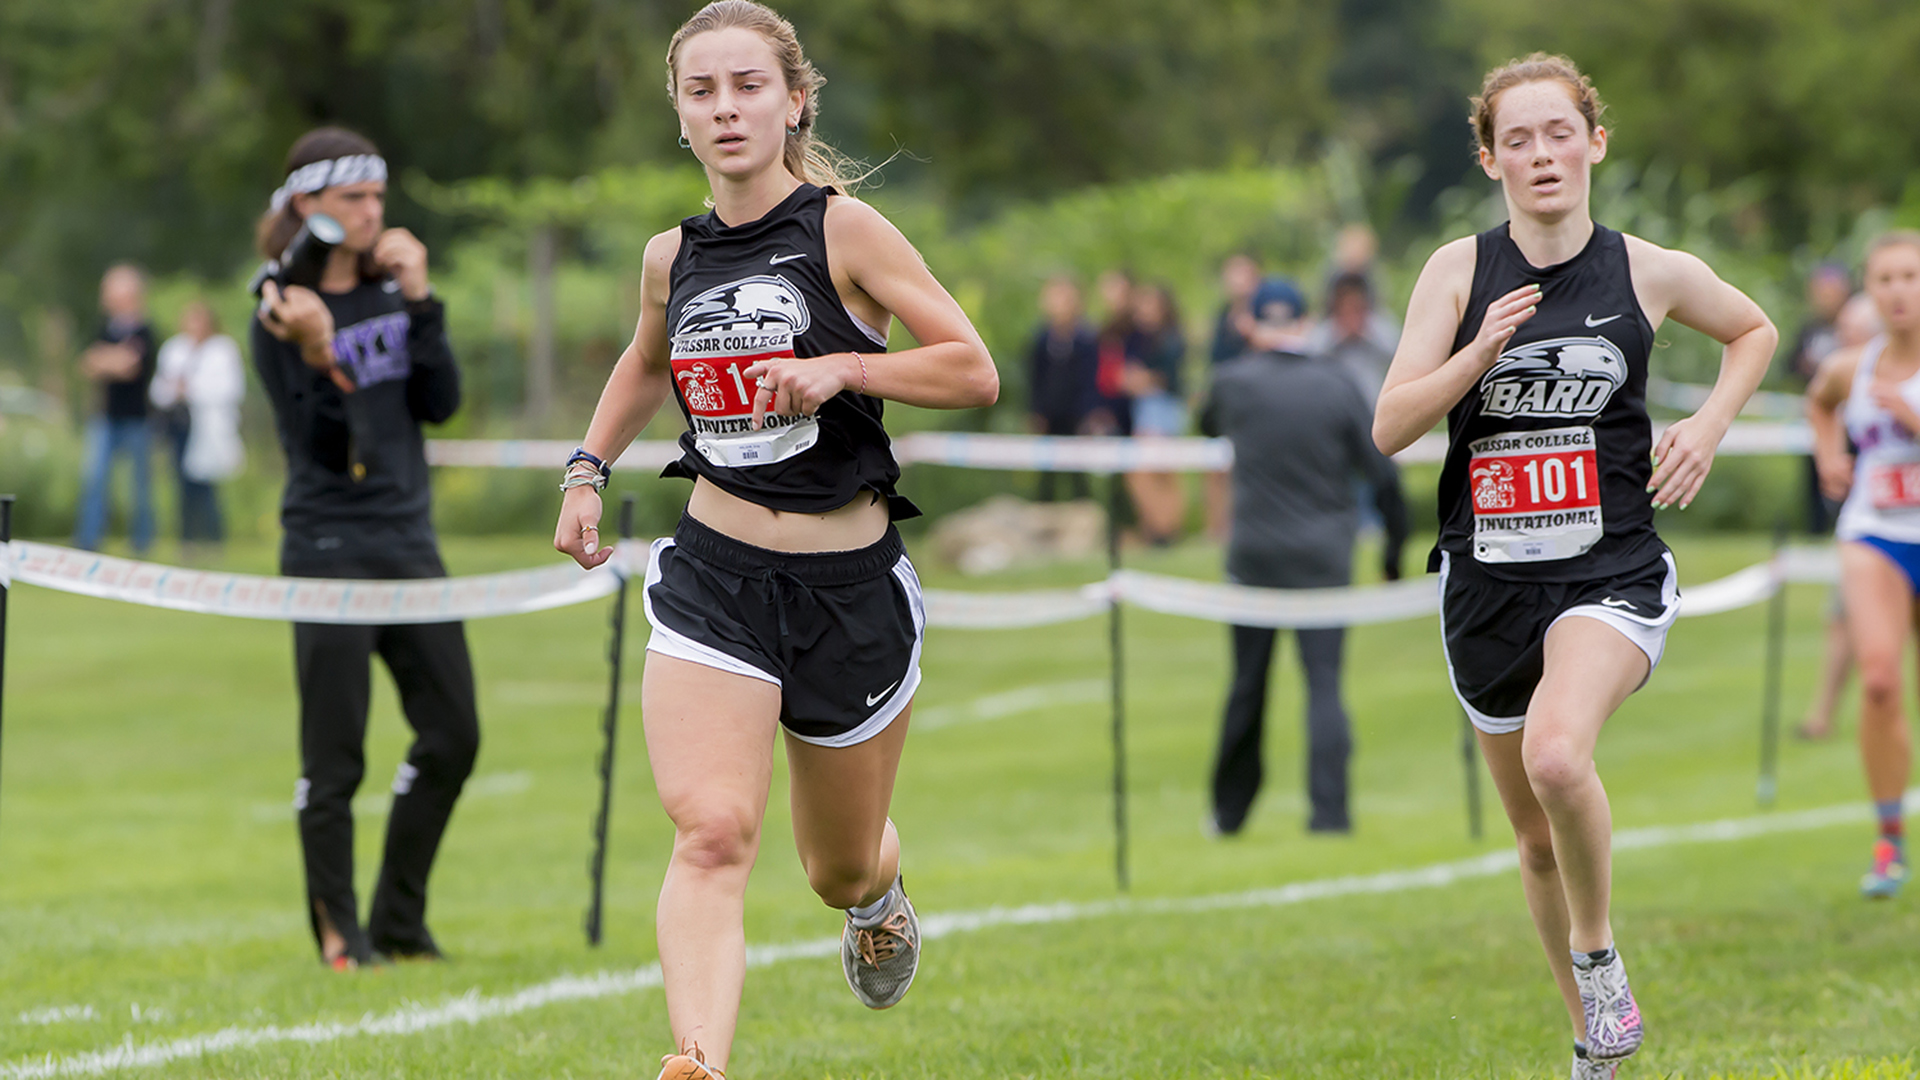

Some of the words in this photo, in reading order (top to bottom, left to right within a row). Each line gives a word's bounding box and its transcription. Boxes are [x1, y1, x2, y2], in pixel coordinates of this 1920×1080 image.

[675, 338, 721, 353] VASSAR
[723, 334, 789, 351] COLLEGE
[1486, 379, 1614, 415] BARD
[696, 412, 812, 434] INVITAIONA
[1472, 438, 1521, 453] VASSAR
[1525, 433, 1591, 448] COLLEGE
[1523, 456, 1587, 504] 101
[1479, 510, 1597, 532] INVITATIONAL
